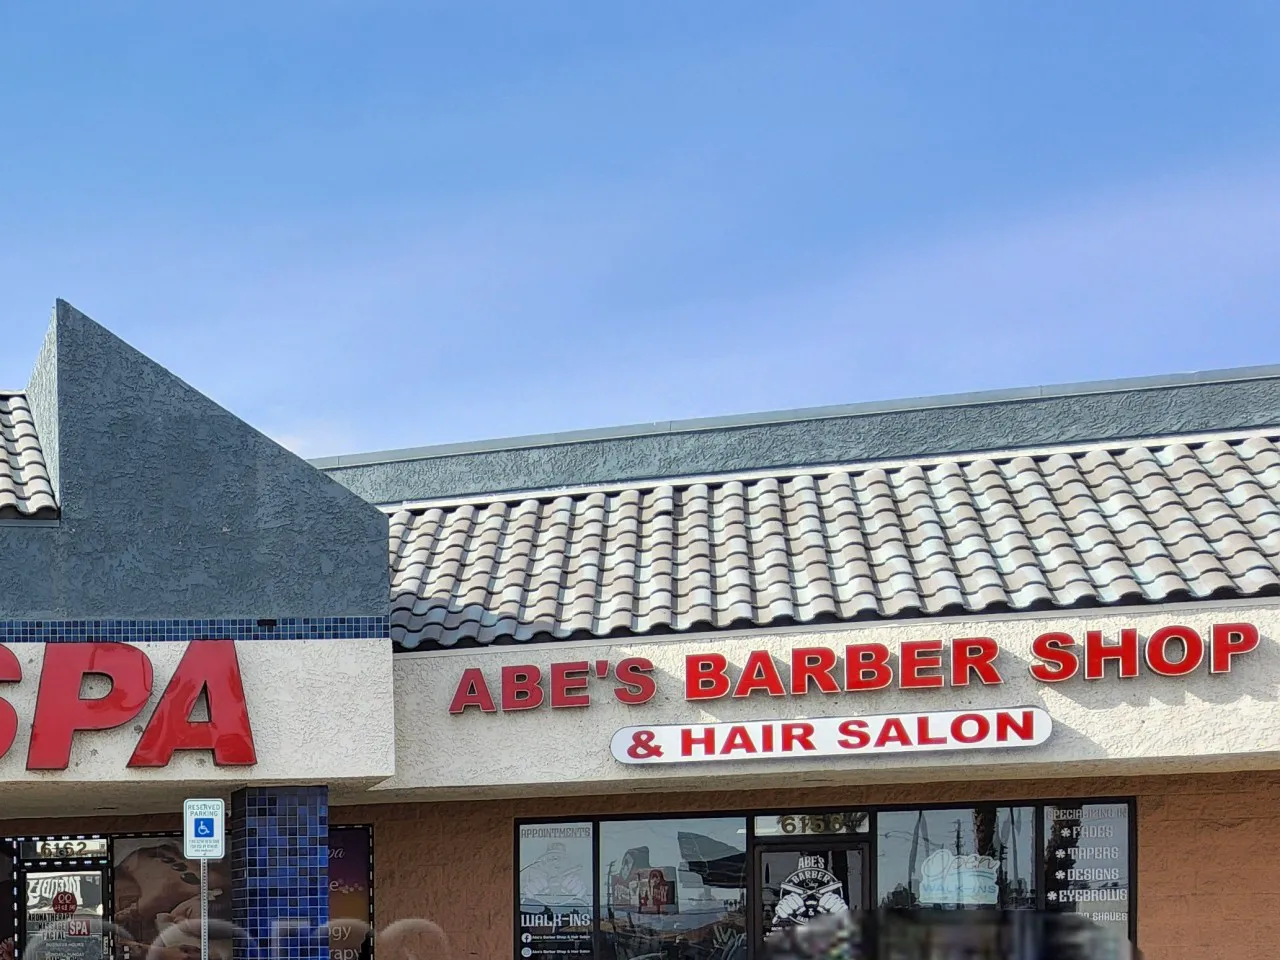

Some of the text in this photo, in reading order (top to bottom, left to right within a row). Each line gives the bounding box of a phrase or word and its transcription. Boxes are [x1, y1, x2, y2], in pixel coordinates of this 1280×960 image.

[448, 621, 1260, 714] ABE'S BARBER SHOP
[627, 709, 1036, 760] & HAIR SALON
[521, 827, 591, 838] APPOINTMENTS
[1073, 826, 1113, 839] FADES
[1068, 847, 1119, 860] TAPERS
[798, 855, 825, 869] ABE'S
[791, 870, 831, 884] BARBER
[1067, 868, 1119, 881] DESIGNS
[923, 884, 997, 894] WALK-INS
[1059, 889, 1128, 902] EYEBROWS
[27, 913, 75, 921] AROMATHERAPY
[521, 913, 591, 927] WALK-INS
[1092, 912, 1128, 921] SHAVES
[69, 921, 89, 935] SPA
[42, 931, 66, 940] FACIAL
